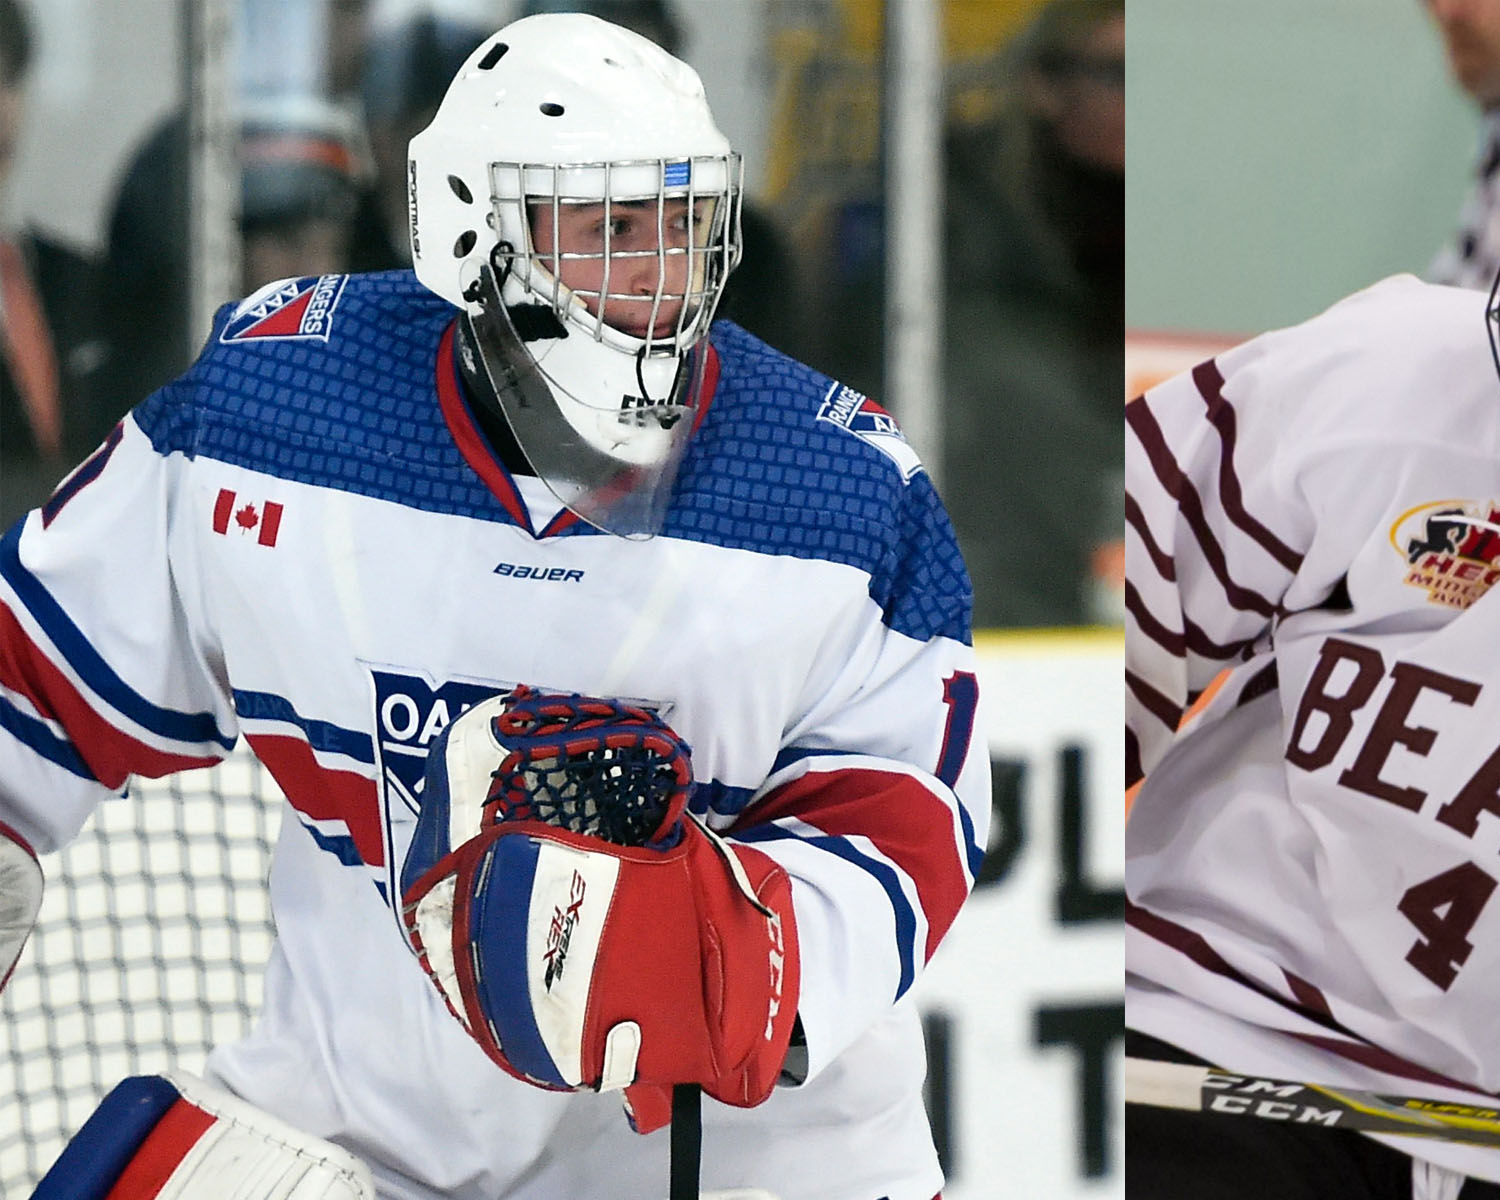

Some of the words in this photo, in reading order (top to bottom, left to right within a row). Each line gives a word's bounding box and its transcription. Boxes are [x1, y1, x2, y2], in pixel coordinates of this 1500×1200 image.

[492, 562, 585, 584] BAUER
[936, 668, 980, 792] 1
[1396, 859, 1499, 993] 4
[1210, 1094, 1344, 1127] CCM
